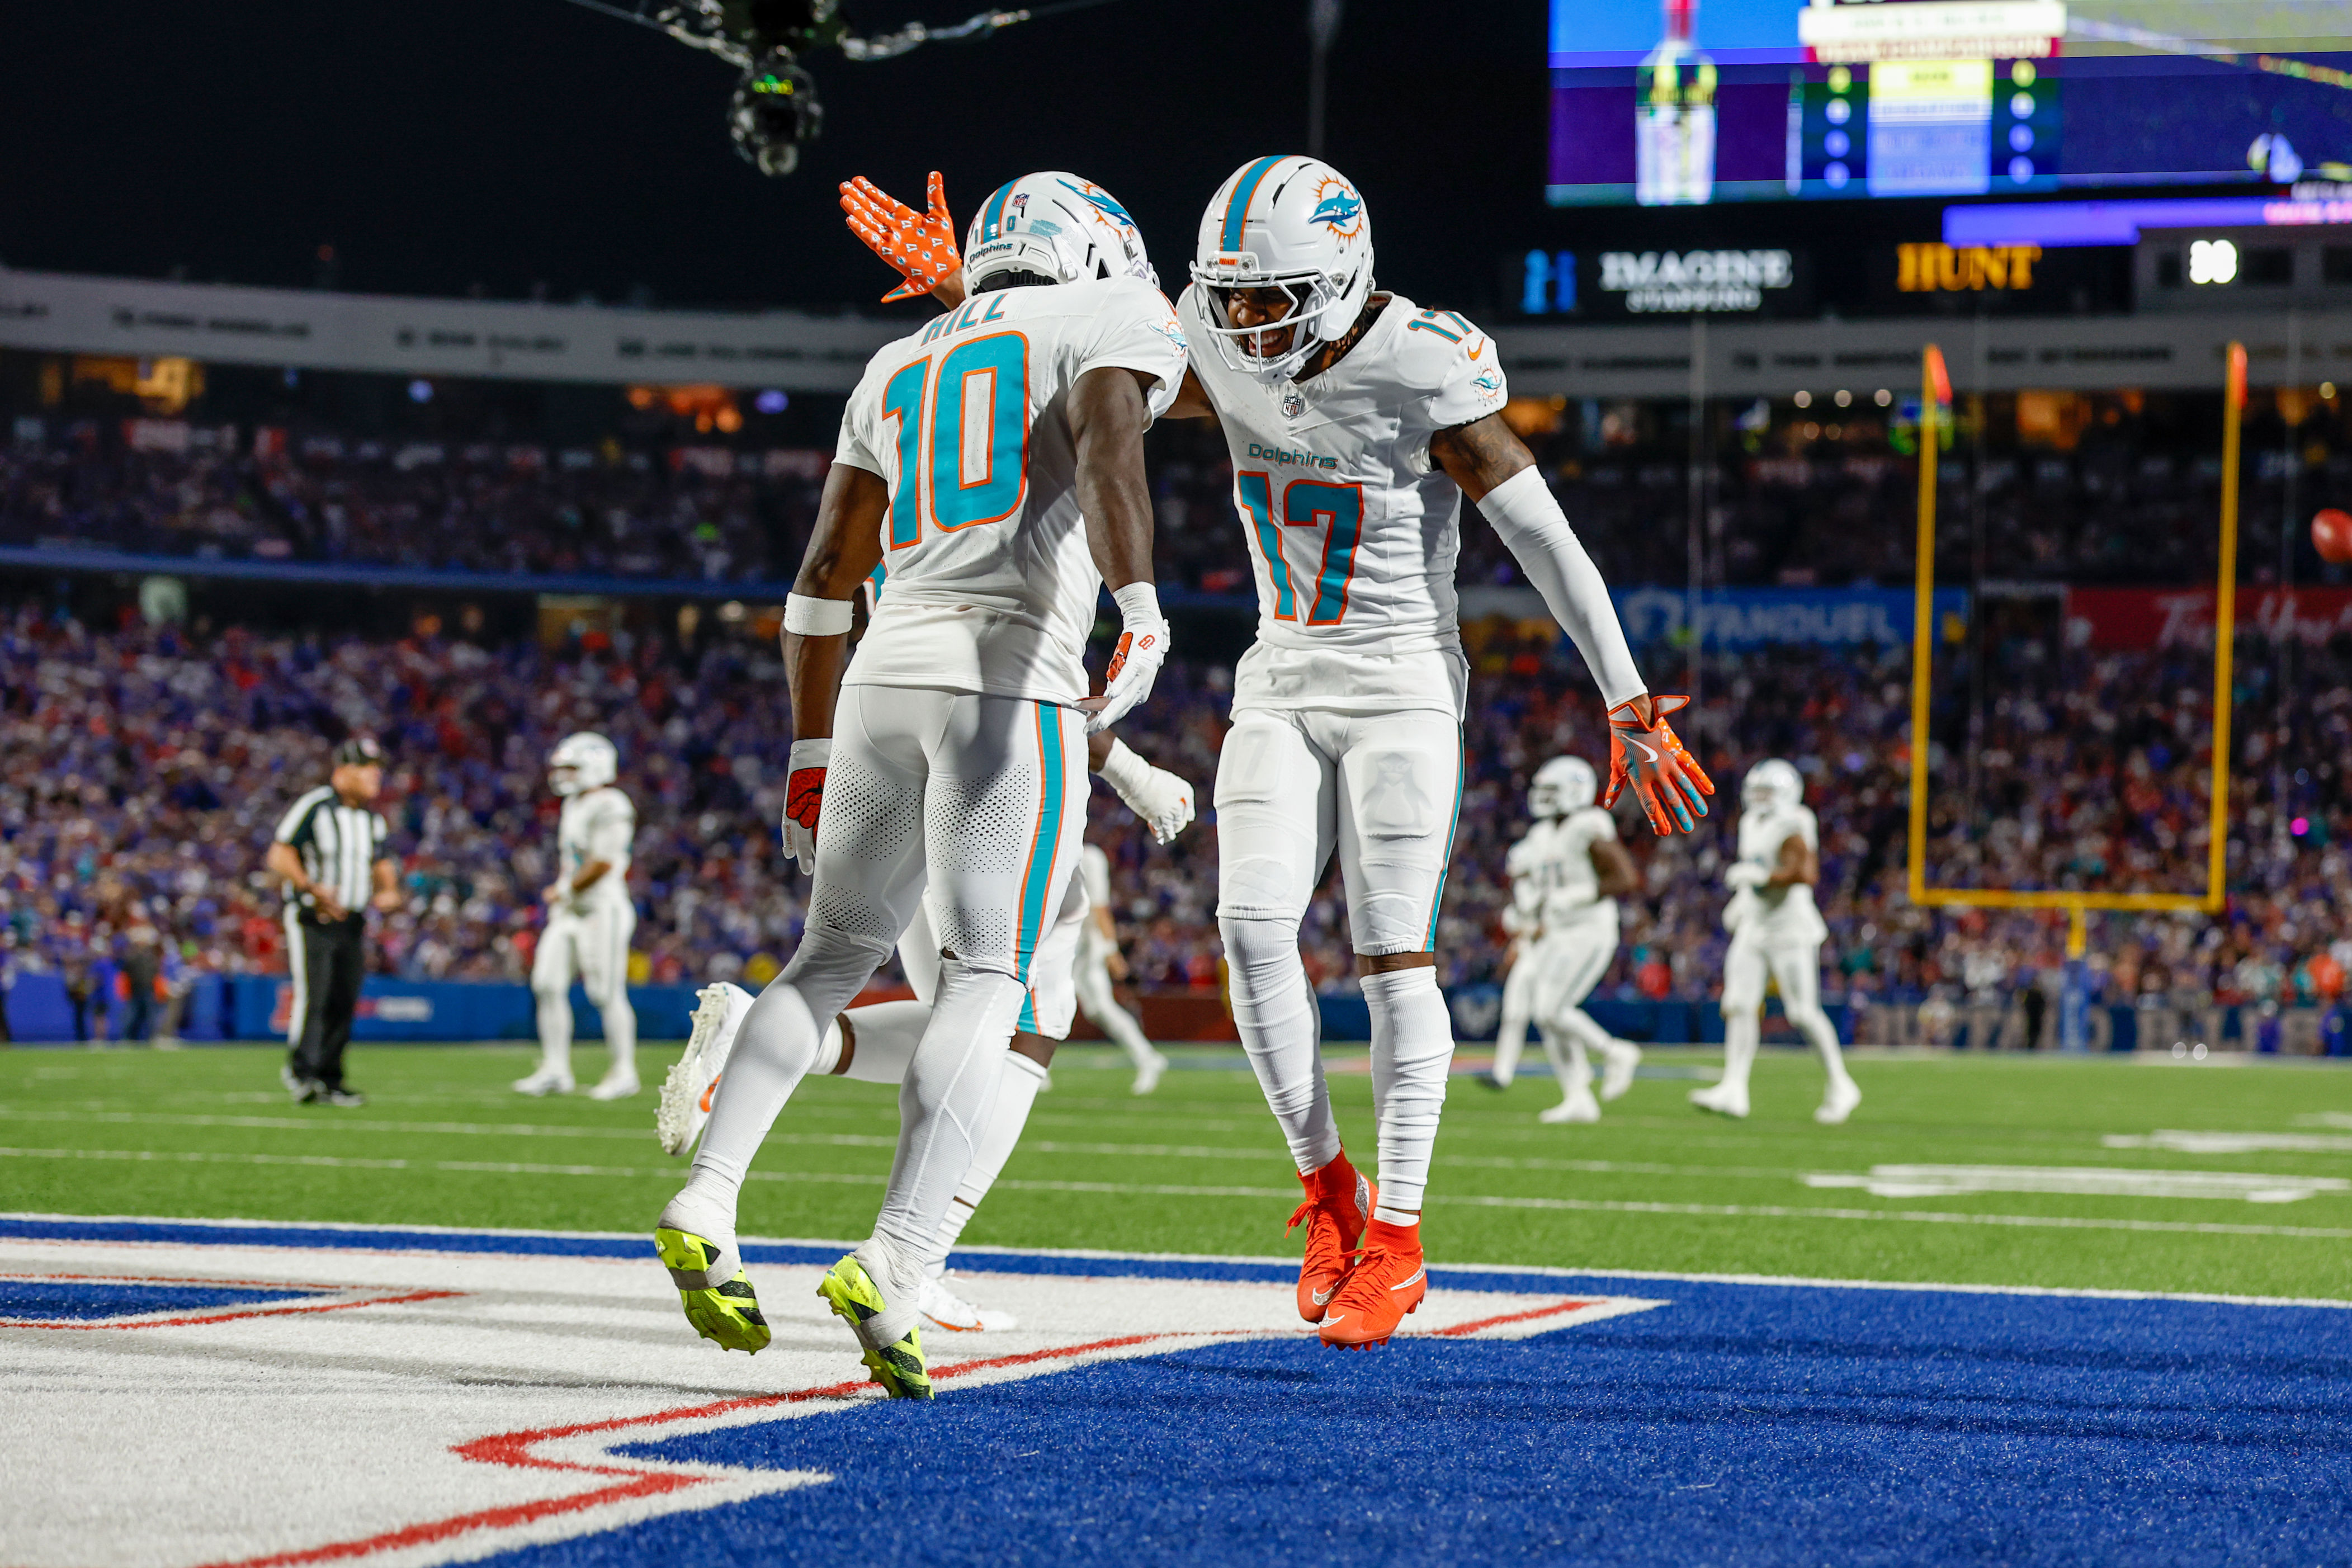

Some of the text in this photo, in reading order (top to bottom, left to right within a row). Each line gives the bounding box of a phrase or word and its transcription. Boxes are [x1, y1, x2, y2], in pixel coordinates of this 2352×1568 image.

[881, 245, 893, 256] 17
[905, 243, 918, 253] 17
[932, 237, 944, 247] 17
[969, 242, 1014, 264] Dolphins
[910, 267, 923, 277] 17
[936, 262, 948, 273] 17
[1598, 249, 1793, 291] IMAGINE
[1896, 242, 2042, 292] HUNT
[920, 292, 1008, 347] HILL
[1407, 309, 1473, 344] 17
[881, 330, 1030, 551] 10
[1248, 443, 1338, 469] Dolphins
[1237, 469, 1364, 626] 17
